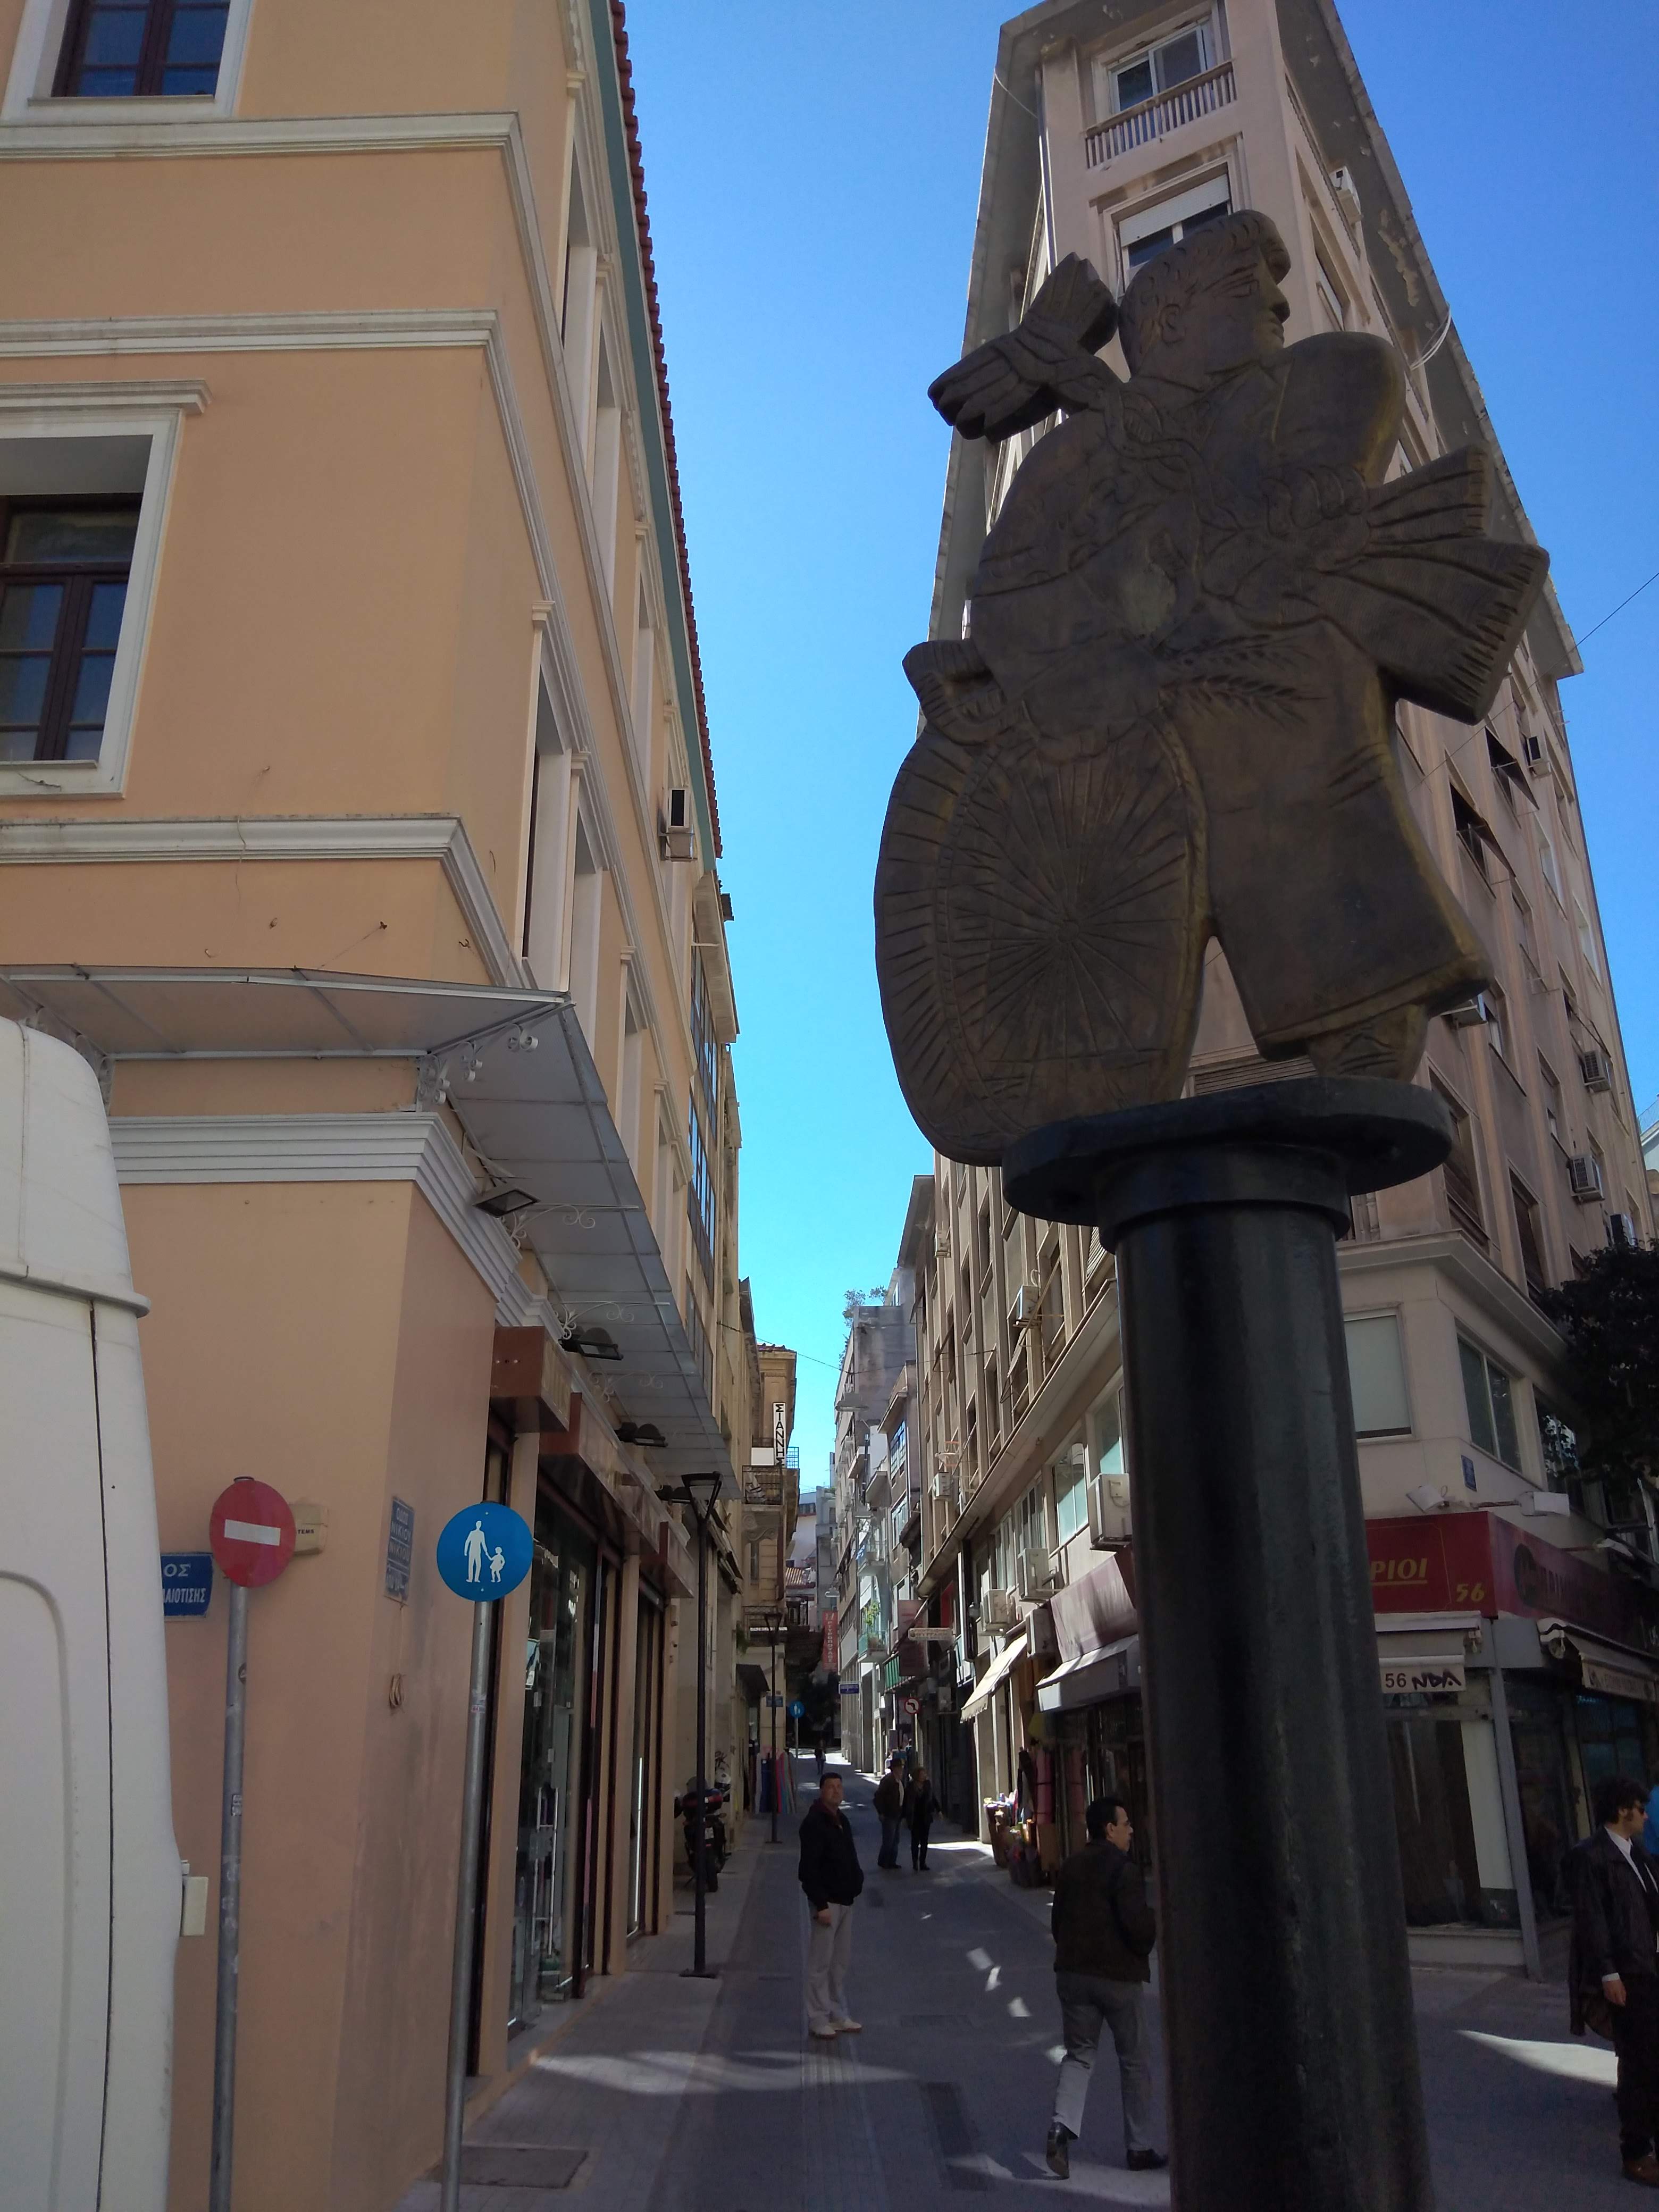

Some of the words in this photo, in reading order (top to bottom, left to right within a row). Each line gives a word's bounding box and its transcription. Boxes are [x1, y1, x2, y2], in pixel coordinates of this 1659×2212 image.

[775, 1404, 784, 1466] ΣΙΑΝΝΗΣ
[164, 1563, 191, 1577] ΟΣ
[1455, 1582, 1485, 1602] 56
[1385, 1673, 1406, 1688] 56
